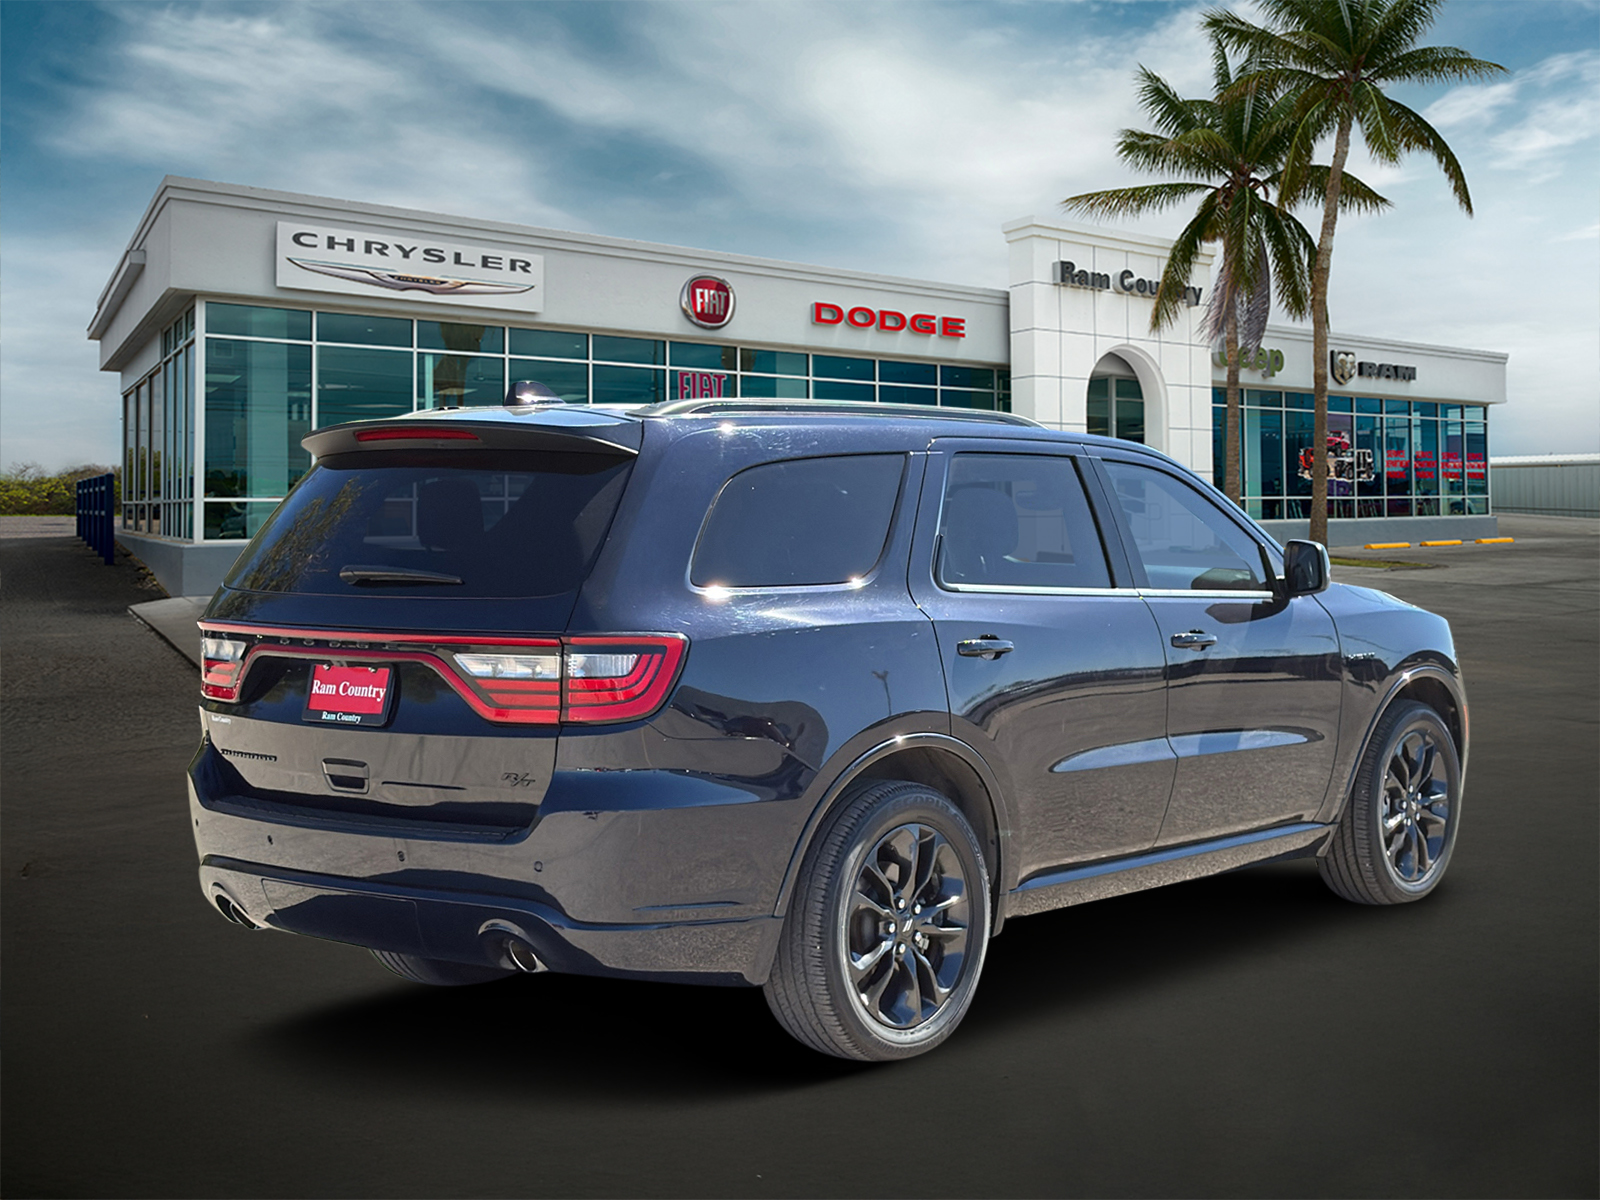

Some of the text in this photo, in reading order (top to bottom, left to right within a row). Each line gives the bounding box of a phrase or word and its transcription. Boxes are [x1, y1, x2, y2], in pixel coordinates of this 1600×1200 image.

[291, 232, 532, 273] CHRYSLER
[1054, 260, 1203, 307] Ram Coury
[695, 288, 728, 316] FIAT
[812, 301, 967, 338] DODGE
[1358, 361, 1417, 380] RAM
[679, 371, 727, 399] FIAT
[311, 680, 386, 702] Ram Country
[322, 711, 361, 724] Ram Country
